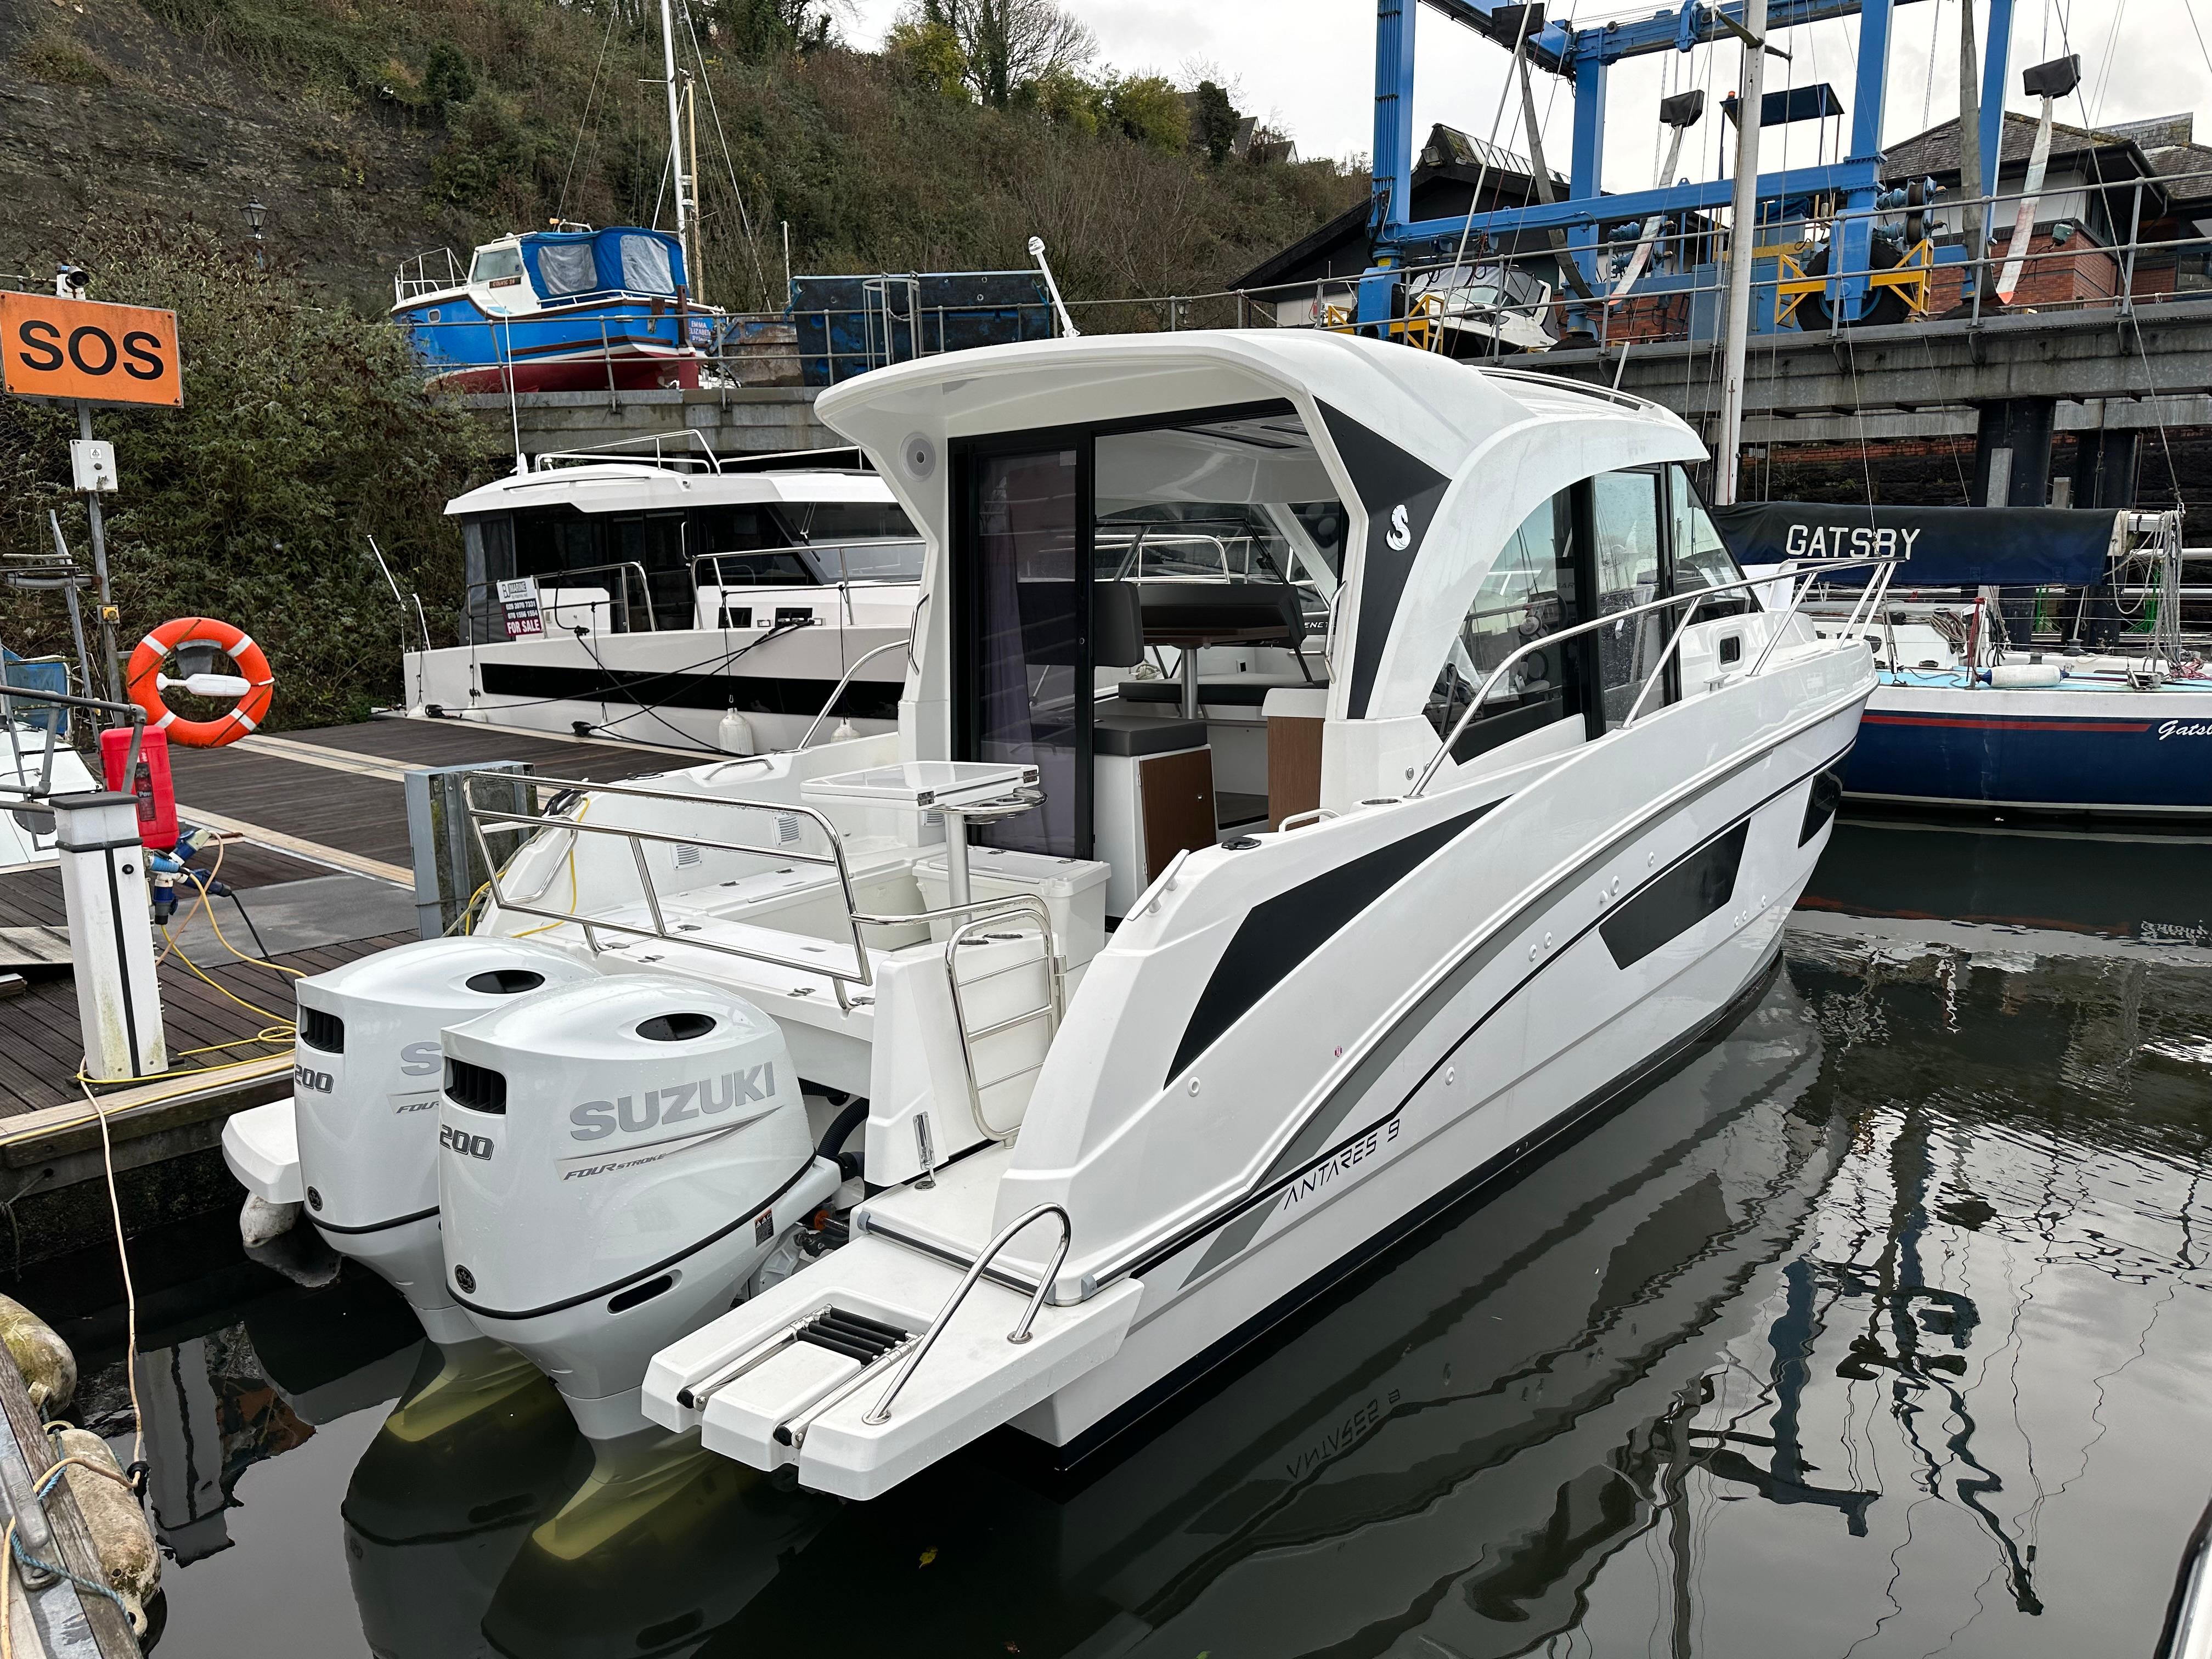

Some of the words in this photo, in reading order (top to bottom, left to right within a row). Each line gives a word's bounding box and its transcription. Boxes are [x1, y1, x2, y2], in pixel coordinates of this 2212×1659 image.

[691, 320, 707, 329] EMMA
[19, 320, 164, 380] SOS
[1786, 524, 1921, 560] GATSBY
[506, 620, 522, 634] FOR
[521, 619, 540, 633] SALE
[2158, 719, 2212, 741] Gatsb
[295, 1063, 334, 1094] 200
[570, 1061, 775, 1141] SUZUKI
[439, 1124, 494, 1161] 200
[1283, 1132, 1378, 1211] ANTARES
[1387, 1118, 1400, 1143] 9
